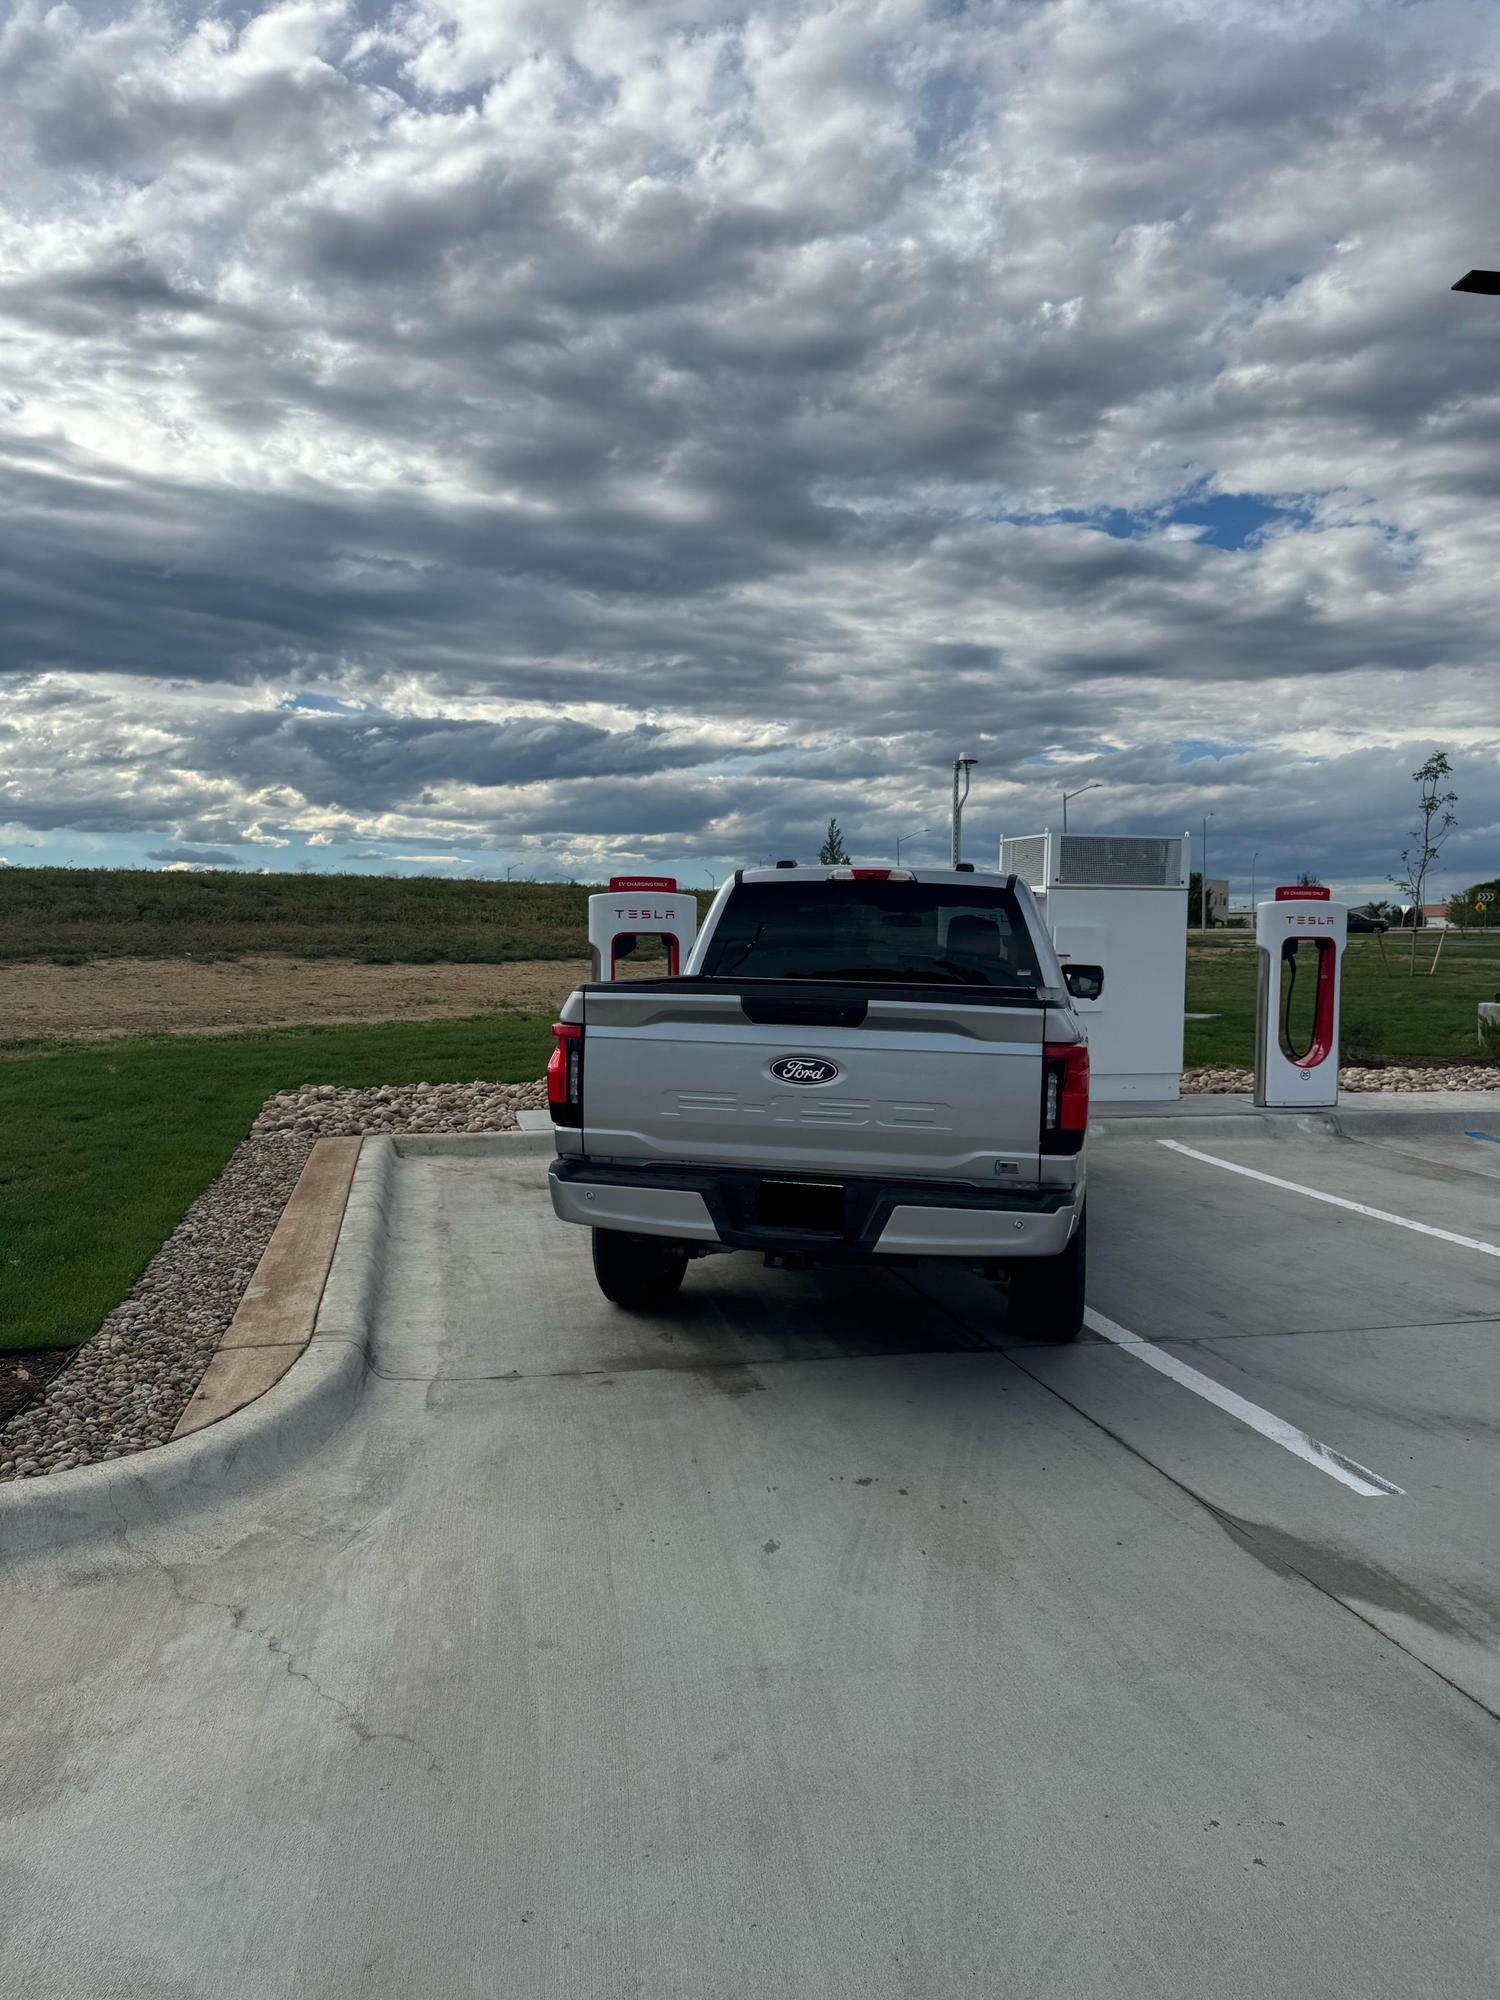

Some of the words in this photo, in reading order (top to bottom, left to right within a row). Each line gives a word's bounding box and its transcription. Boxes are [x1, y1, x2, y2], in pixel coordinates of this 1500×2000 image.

[614, 909, 674, 919] TESLA
[1285, 916, 1334, 925] TESLA
[782, 1060, 825, 1079] Ford
[660, 1089, 953, 1130] F-150
